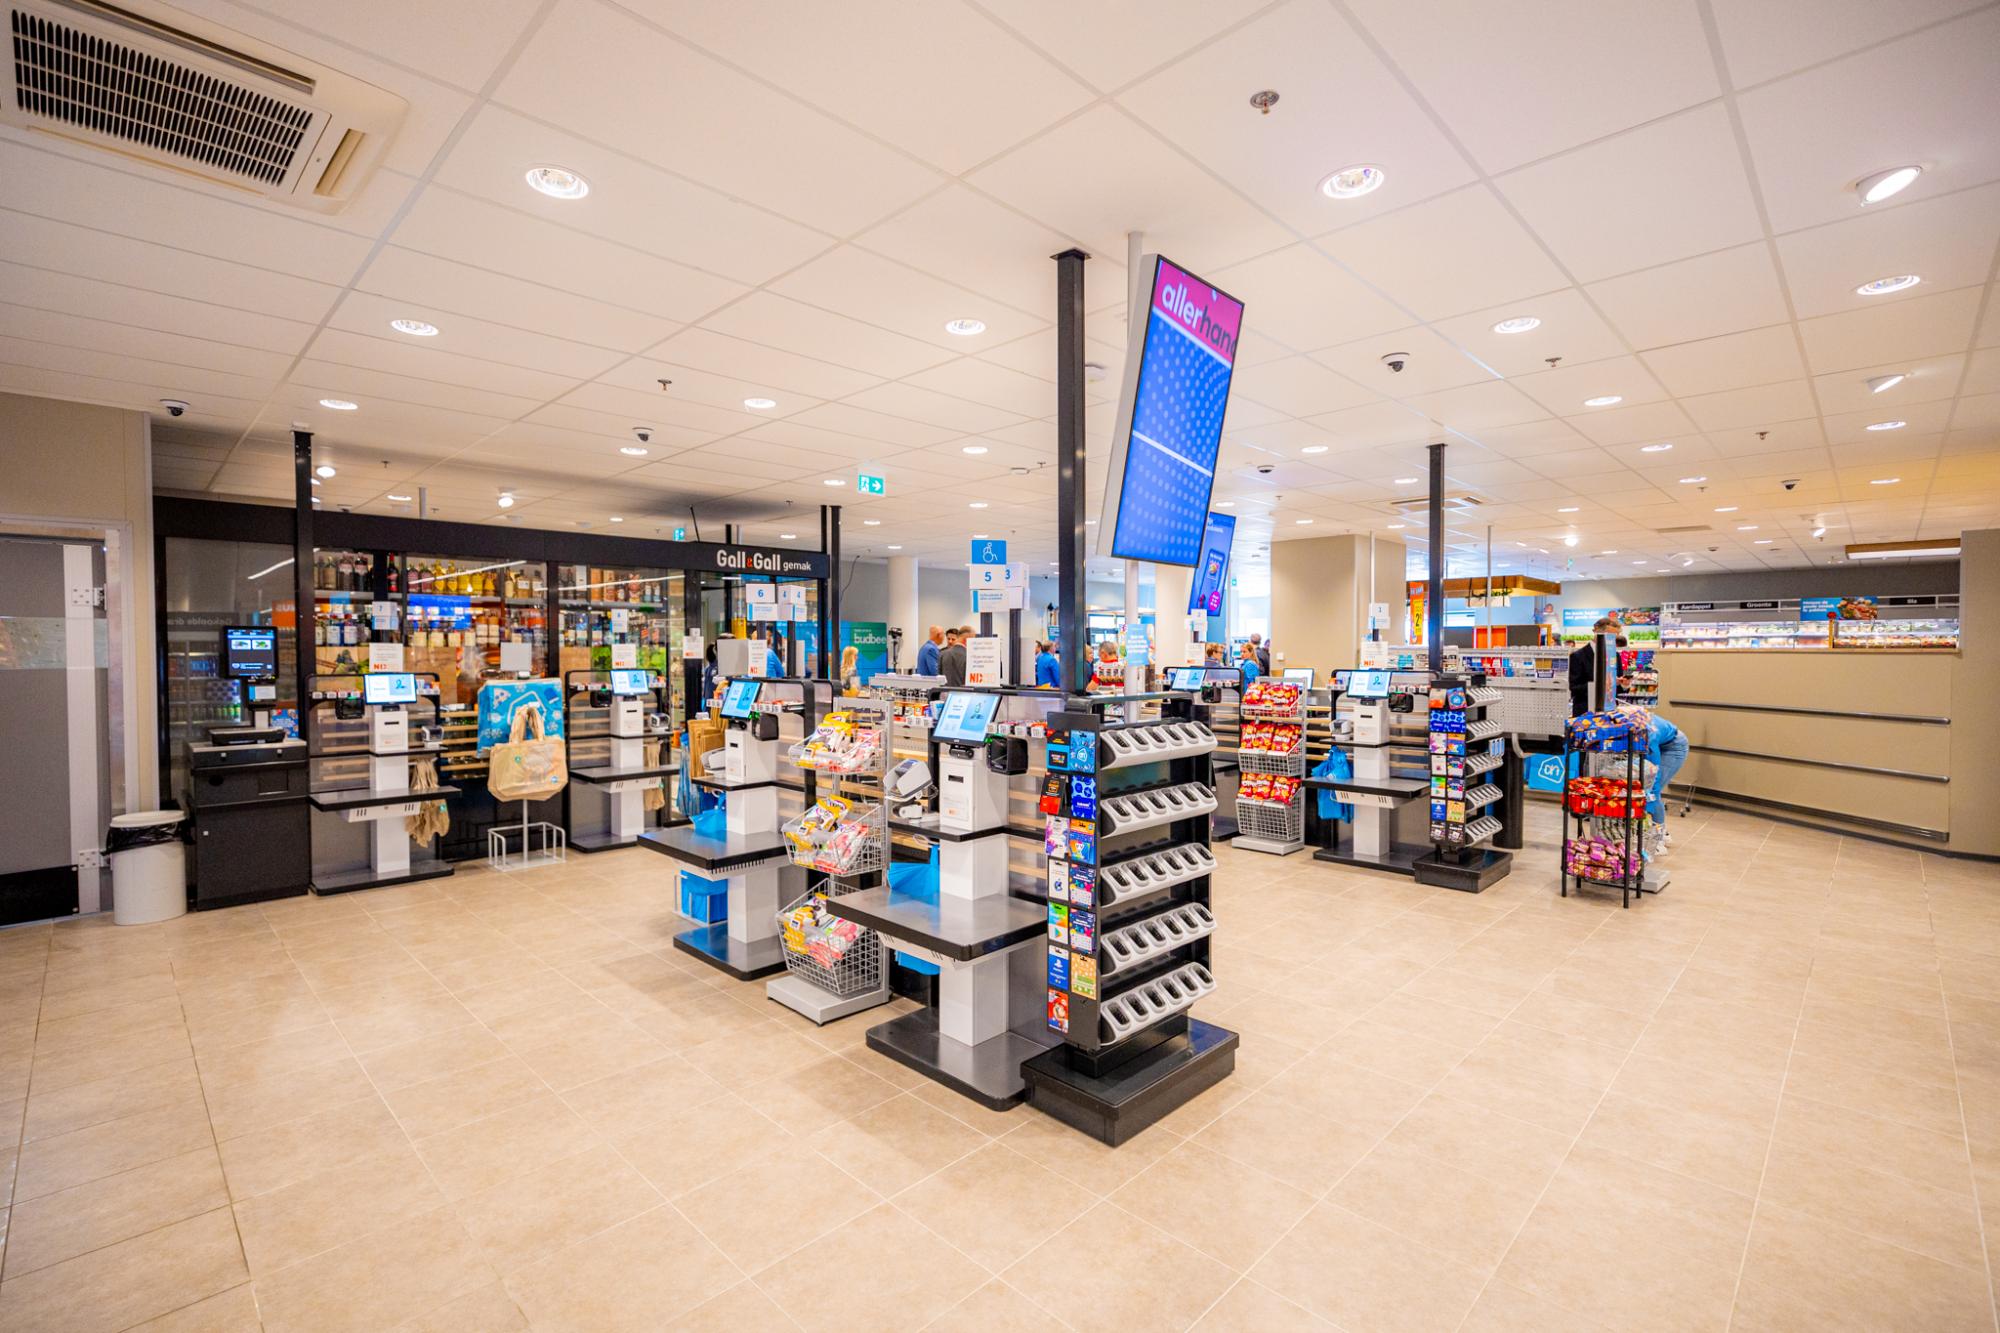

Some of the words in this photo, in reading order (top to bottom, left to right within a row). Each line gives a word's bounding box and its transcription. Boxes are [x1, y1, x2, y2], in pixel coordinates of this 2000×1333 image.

[783, 560, 811, 571] gemak
[984, 571, 992, 582] 5
[1005, 569, 1011, 580] 3
[757, 589, 764, 598] 6
[1746, 600, 1772, 608] Groente
[854, 633, 887, 644] budbee
